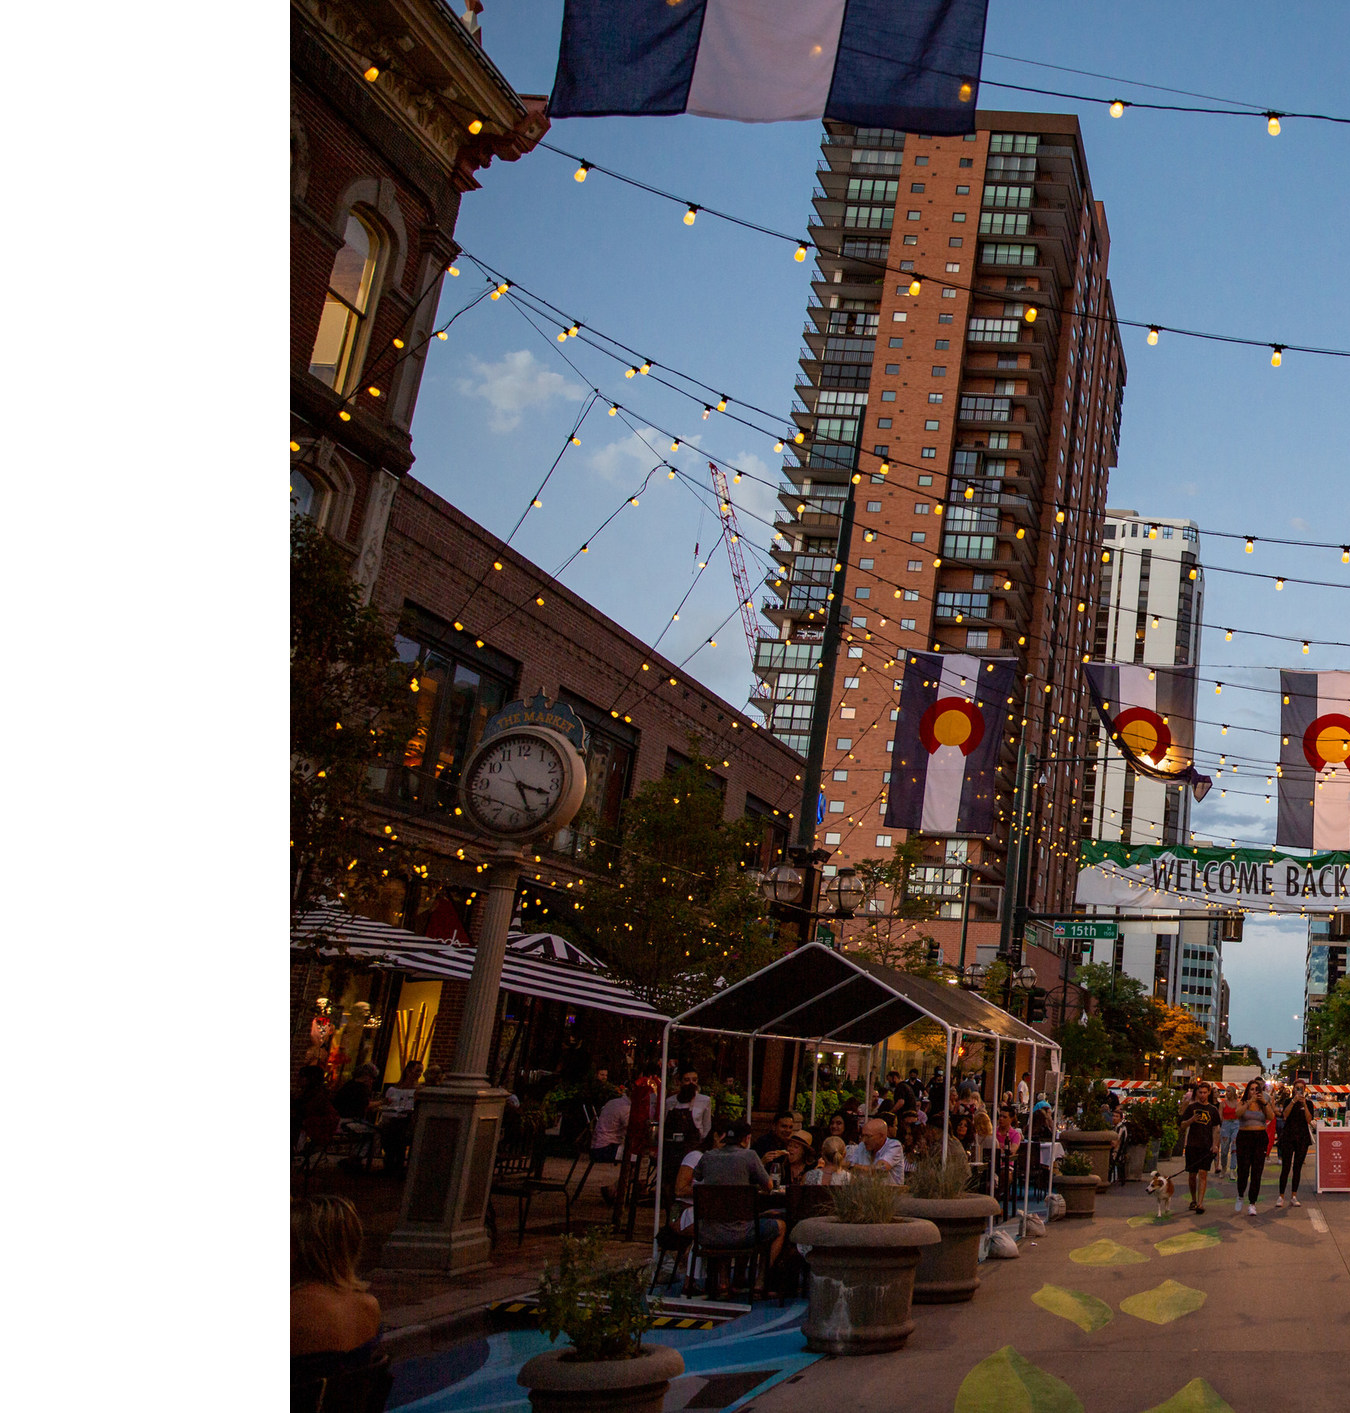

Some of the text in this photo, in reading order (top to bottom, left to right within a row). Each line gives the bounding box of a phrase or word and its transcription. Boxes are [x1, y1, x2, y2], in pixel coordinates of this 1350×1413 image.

[497, 712, 576, 733] THE MARKET
[501, 750, 511, 762] 11
[517, 745, 531, 757] 12
[540, 750, 545, 762] 1
[488, 762, 502, 774] 10
[548, 762, 557, 774] 2
[479, 778, 490, 790] 9
[549, 778, 559, 790] 3
[540, 797, 551, 809] 4
[492, 808, 502, 820] 7
[510, 812, 520, 824] 6
[1152, 858, 1273, 895] WELCOME
[1286, 864, 1350, 897] BACK
[1071, 925, 1096, 936] 15th
